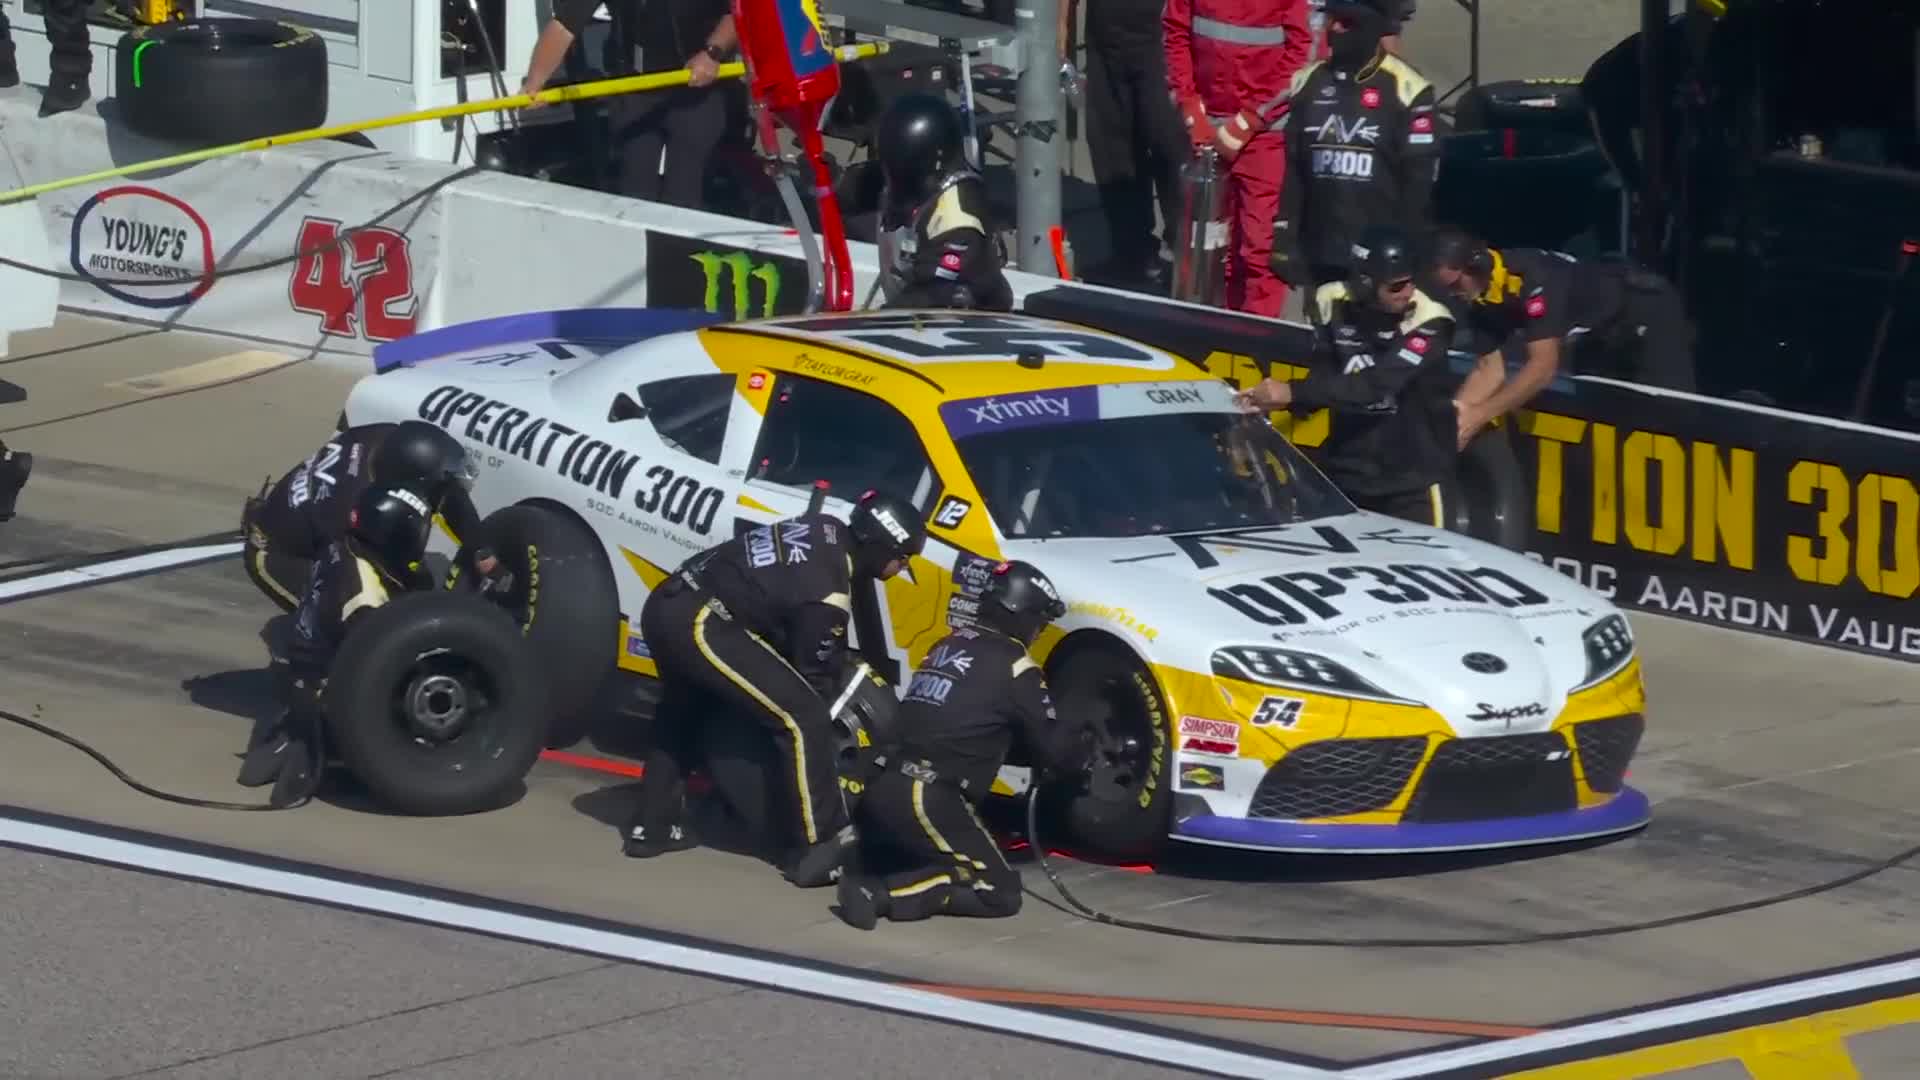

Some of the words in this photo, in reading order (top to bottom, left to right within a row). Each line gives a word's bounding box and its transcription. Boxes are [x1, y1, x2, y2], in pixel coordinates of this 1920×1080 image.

[102, 215, 188, 262] YOUNG'S
[89, 254, 193, 281] MOTORSPORTS
[288, 215, 419, 343] 42
[968, 391, 1071, 426] xfinity
[1145, 388, 1205, 405] GRAY
[418, 385, 641, 500] OPERATION
[634, 465, 725, 536] 300
[618, 511, 658, 535] AARON
[871, 507, 910, 544] JGR
[935, 500, 970, 526] 12
[1206, 563, 1550, 627] OP300
[1637, 575, 1790, 632] AARON
[1253, 696, 1304, 726] 54
[1466, 702, 1548, 727] Supra
[1181, 717, 1237, 739] SIMPSON
